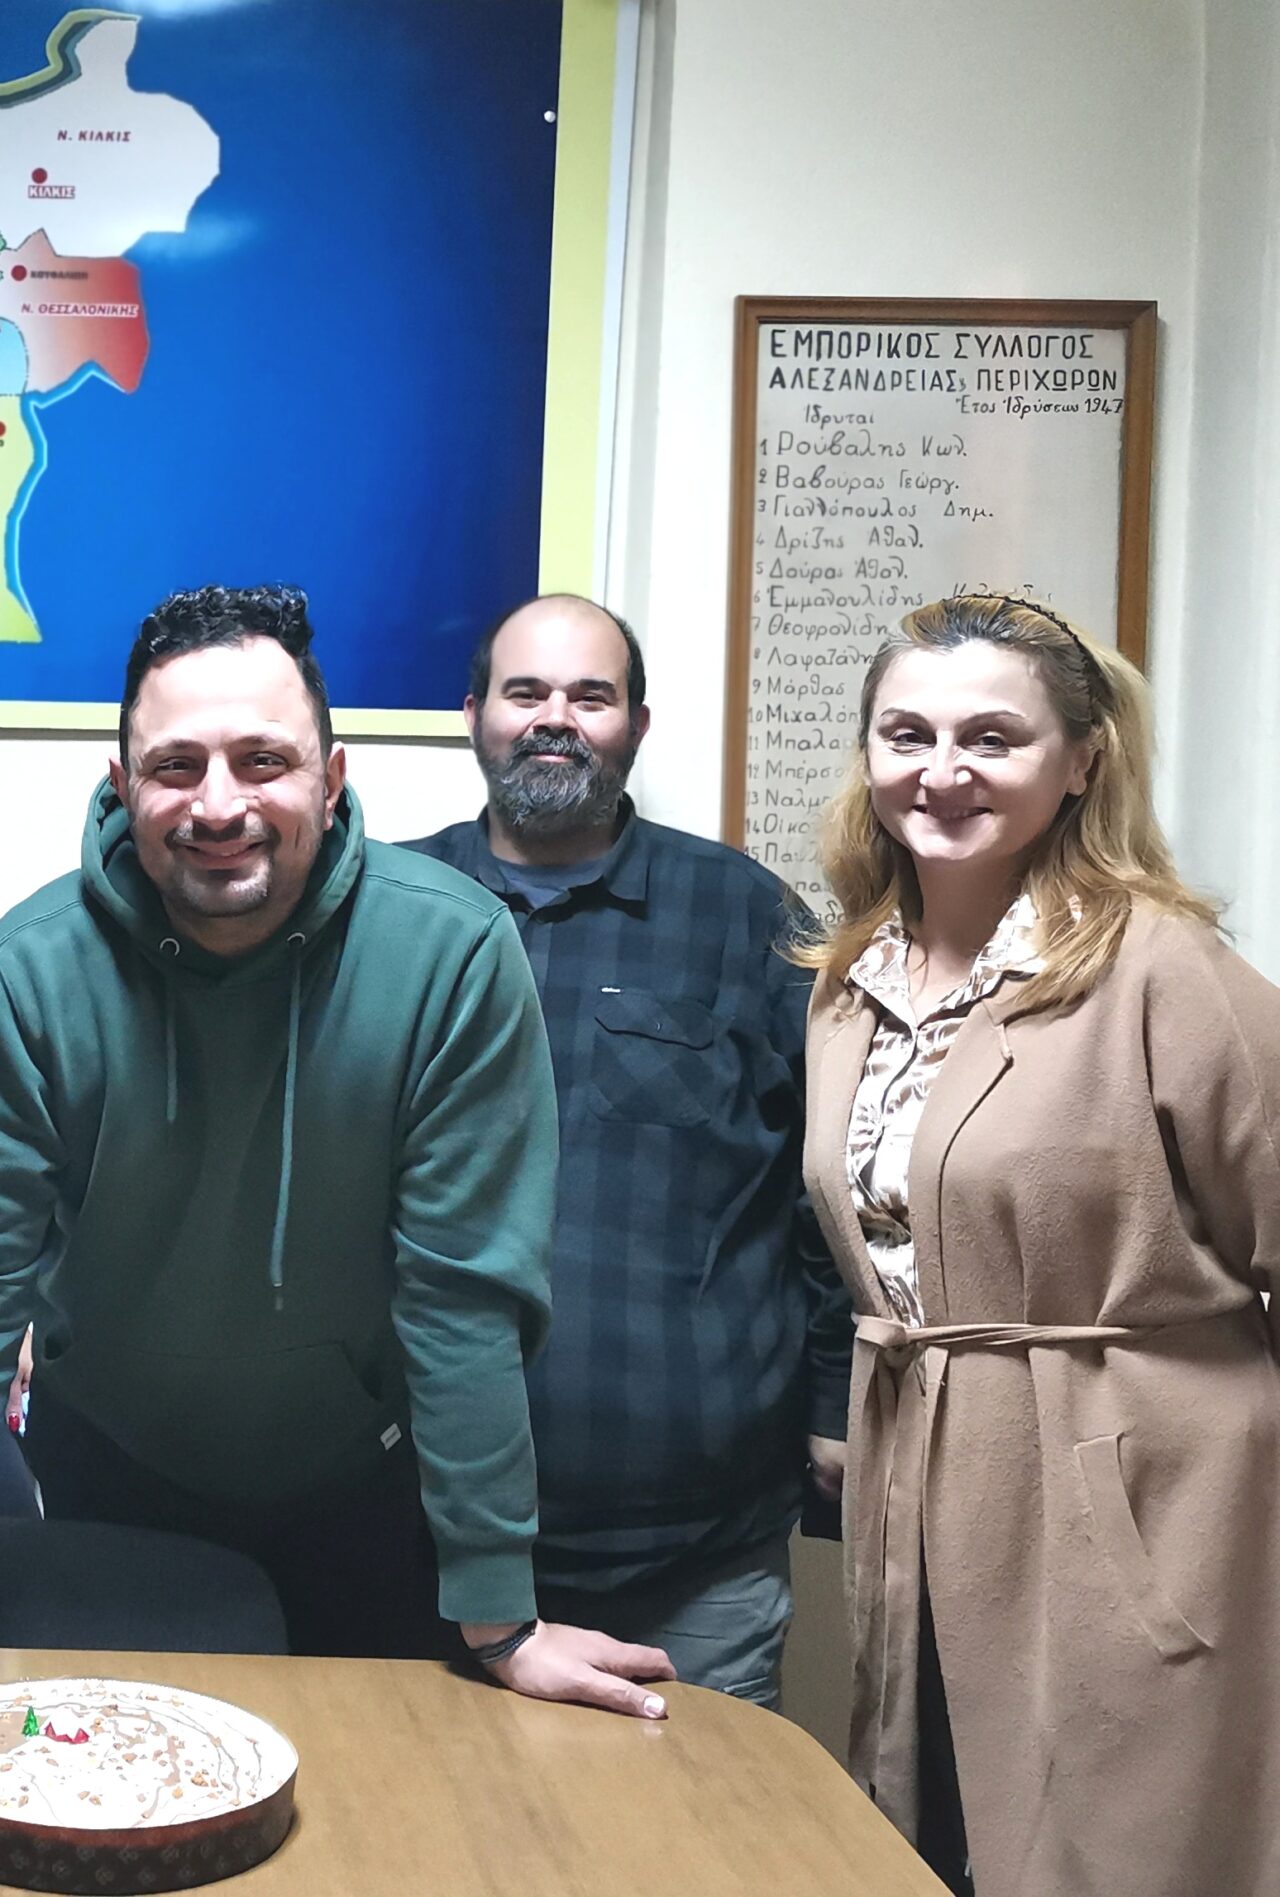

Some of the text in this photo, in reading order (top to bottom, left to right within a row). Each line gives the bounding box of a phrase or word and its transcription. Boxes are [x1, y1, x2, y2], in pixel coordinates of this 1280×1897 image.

[78, 131, 131, 142] ΚΙΛΚΙΣ
[28, 185, 76, 199] ΚΙΛΚΙΣ
[38, 304, 138, 316] ΘΕΣΣΑΛΟΝΙΚΗΣ
[770, 329, 1095, 362] ΕΜΠΟΡΙΚΟΣ ΣΥΛΛΟΓΟΣ
[976, 368, 1118, 392] ΠΕΡΙΧΩΡΩΝ
[1084, 397, 1124, 415] 1947
[757, 499, 767, 513] 3
[768, 611, 888, 642] Θεοφρονίδη
[767, 645, 874, 672] Λαφαζάνη
[752, 678, 762, 695] 9
[765, 701, 859, 724] Μιχαλόπ
